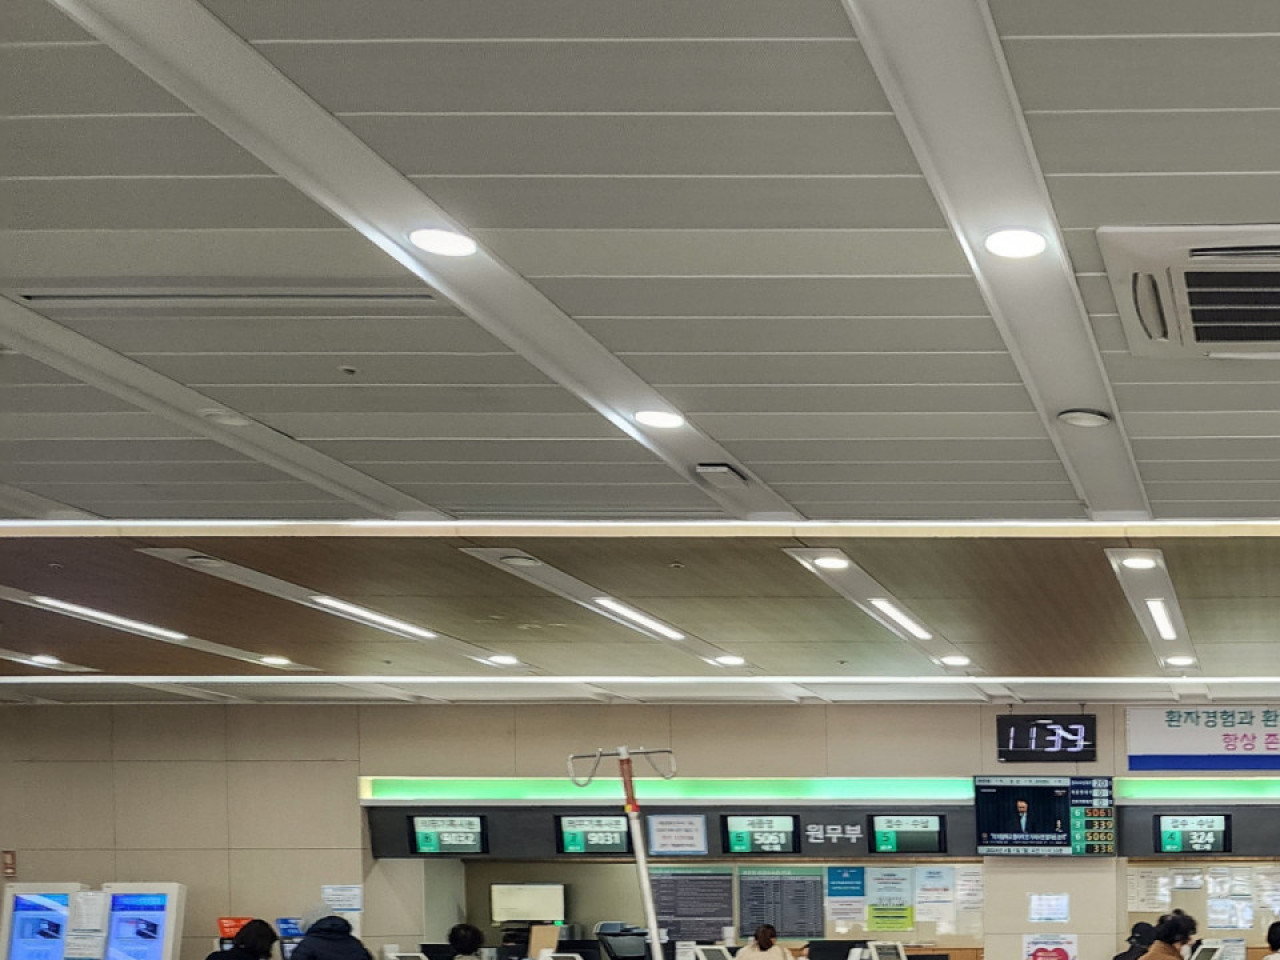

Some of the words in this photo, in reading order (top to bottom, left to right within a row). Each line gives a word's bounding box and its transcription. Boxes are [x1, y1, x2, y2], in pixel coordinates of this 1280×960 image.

[1164, 709, 1255, 728] 환자경험과
[1222, 732, 1256, 750] 항상
[753, 832, 786, 844] 5061
[805, 824, 863, 843] 원무부
[1188, 831, 1216, 844] 324
